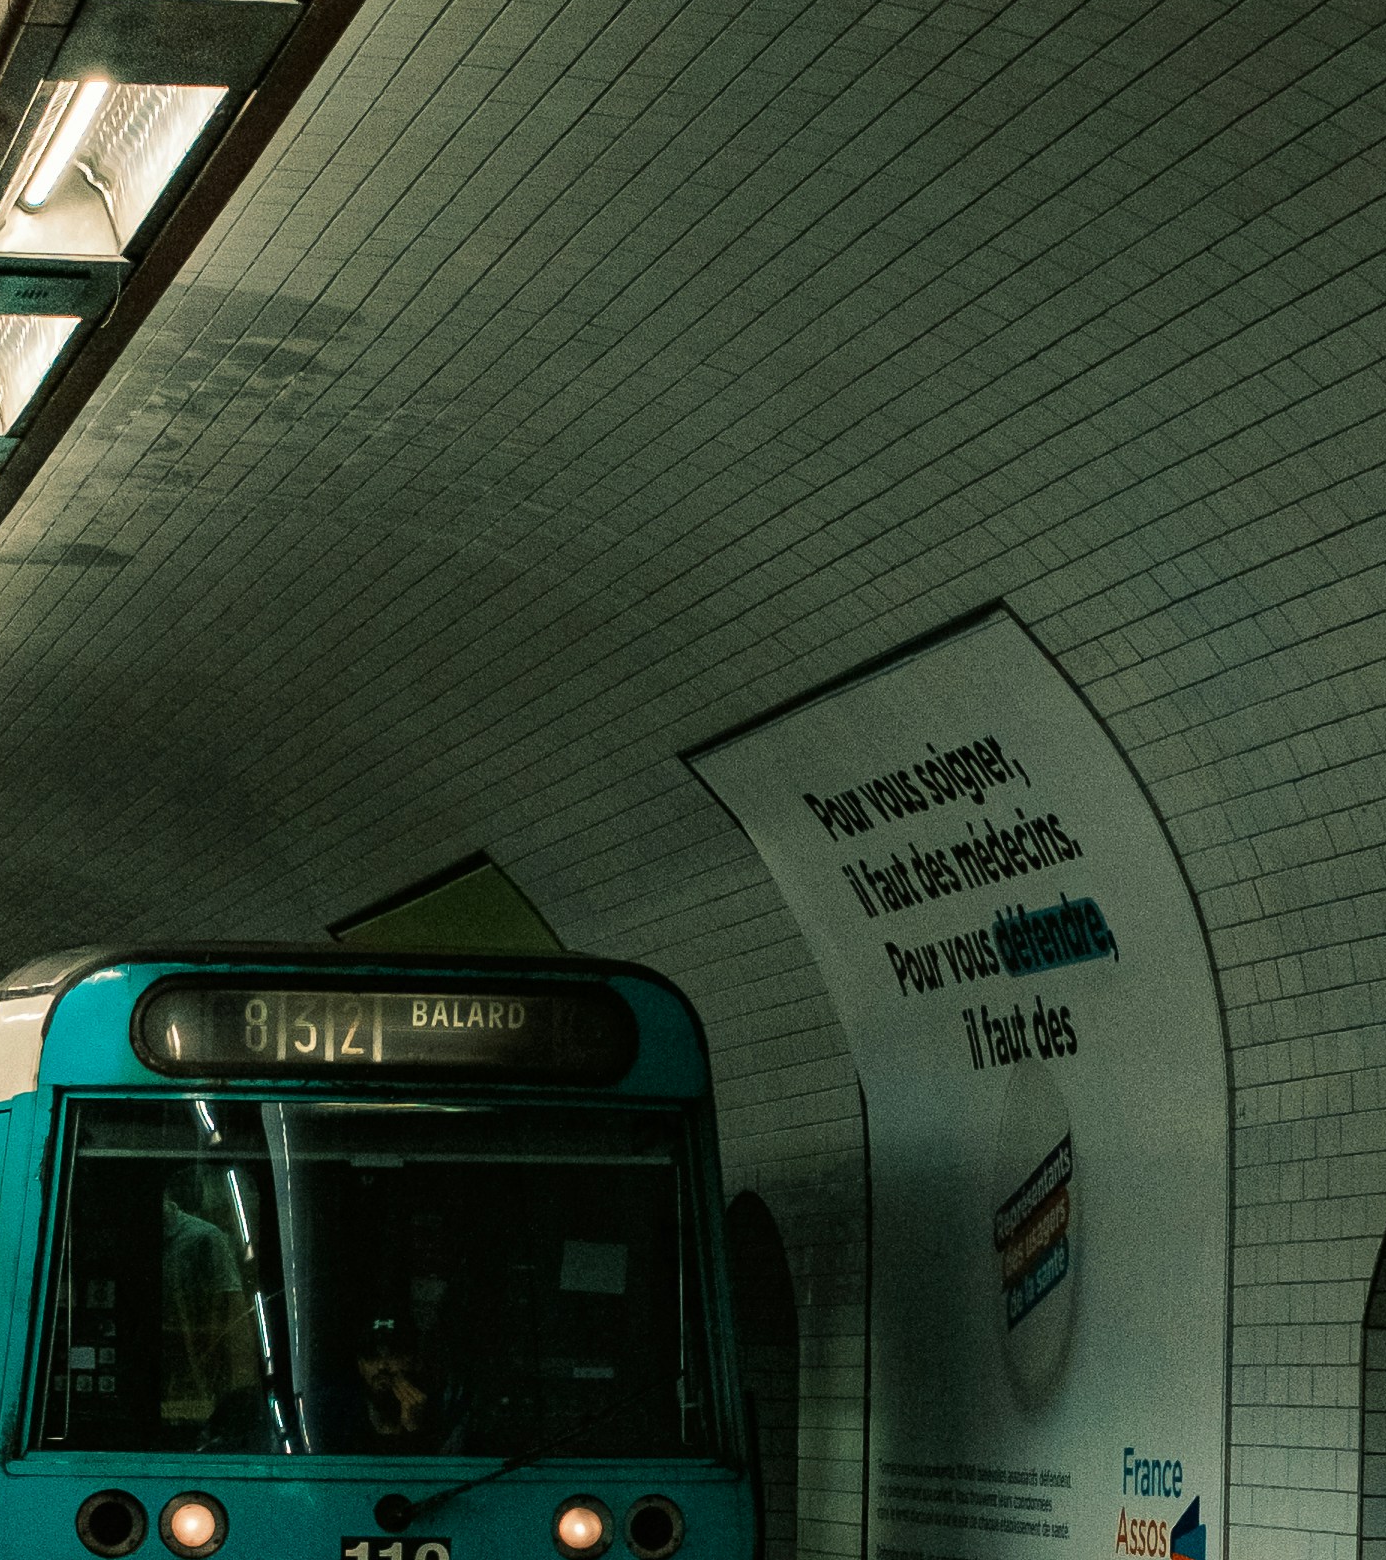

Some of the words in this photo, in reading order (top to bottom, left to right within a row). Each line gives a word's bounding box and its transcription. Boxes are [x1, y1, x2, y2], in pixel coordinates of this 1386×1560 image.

[802, 789, 874, 842] Pour
[858, 769, 929, 822] vous
[914, 734, 1031, 805] soigner,
[908, 842, 962, 900] des
[950, 807, 1083, 889] médecins.
[841, 864, 878, 918] il
[859, 852, 923, 913] faut
[884, 941, 944, 997] Pour
[938, 928, 1001, 984] vous
[994, 891, 1120, 972] défendre,
[412, 1000, 526, 1030] BALARD
[962, 1008, 984, 1070] il
[981, 1003, 1032, 1067] faut
[1032, 995, 1078, 1060] des
[1123, 1447, 1183, 1498] France
[1115, 1506, 1167, 1558] Assos
